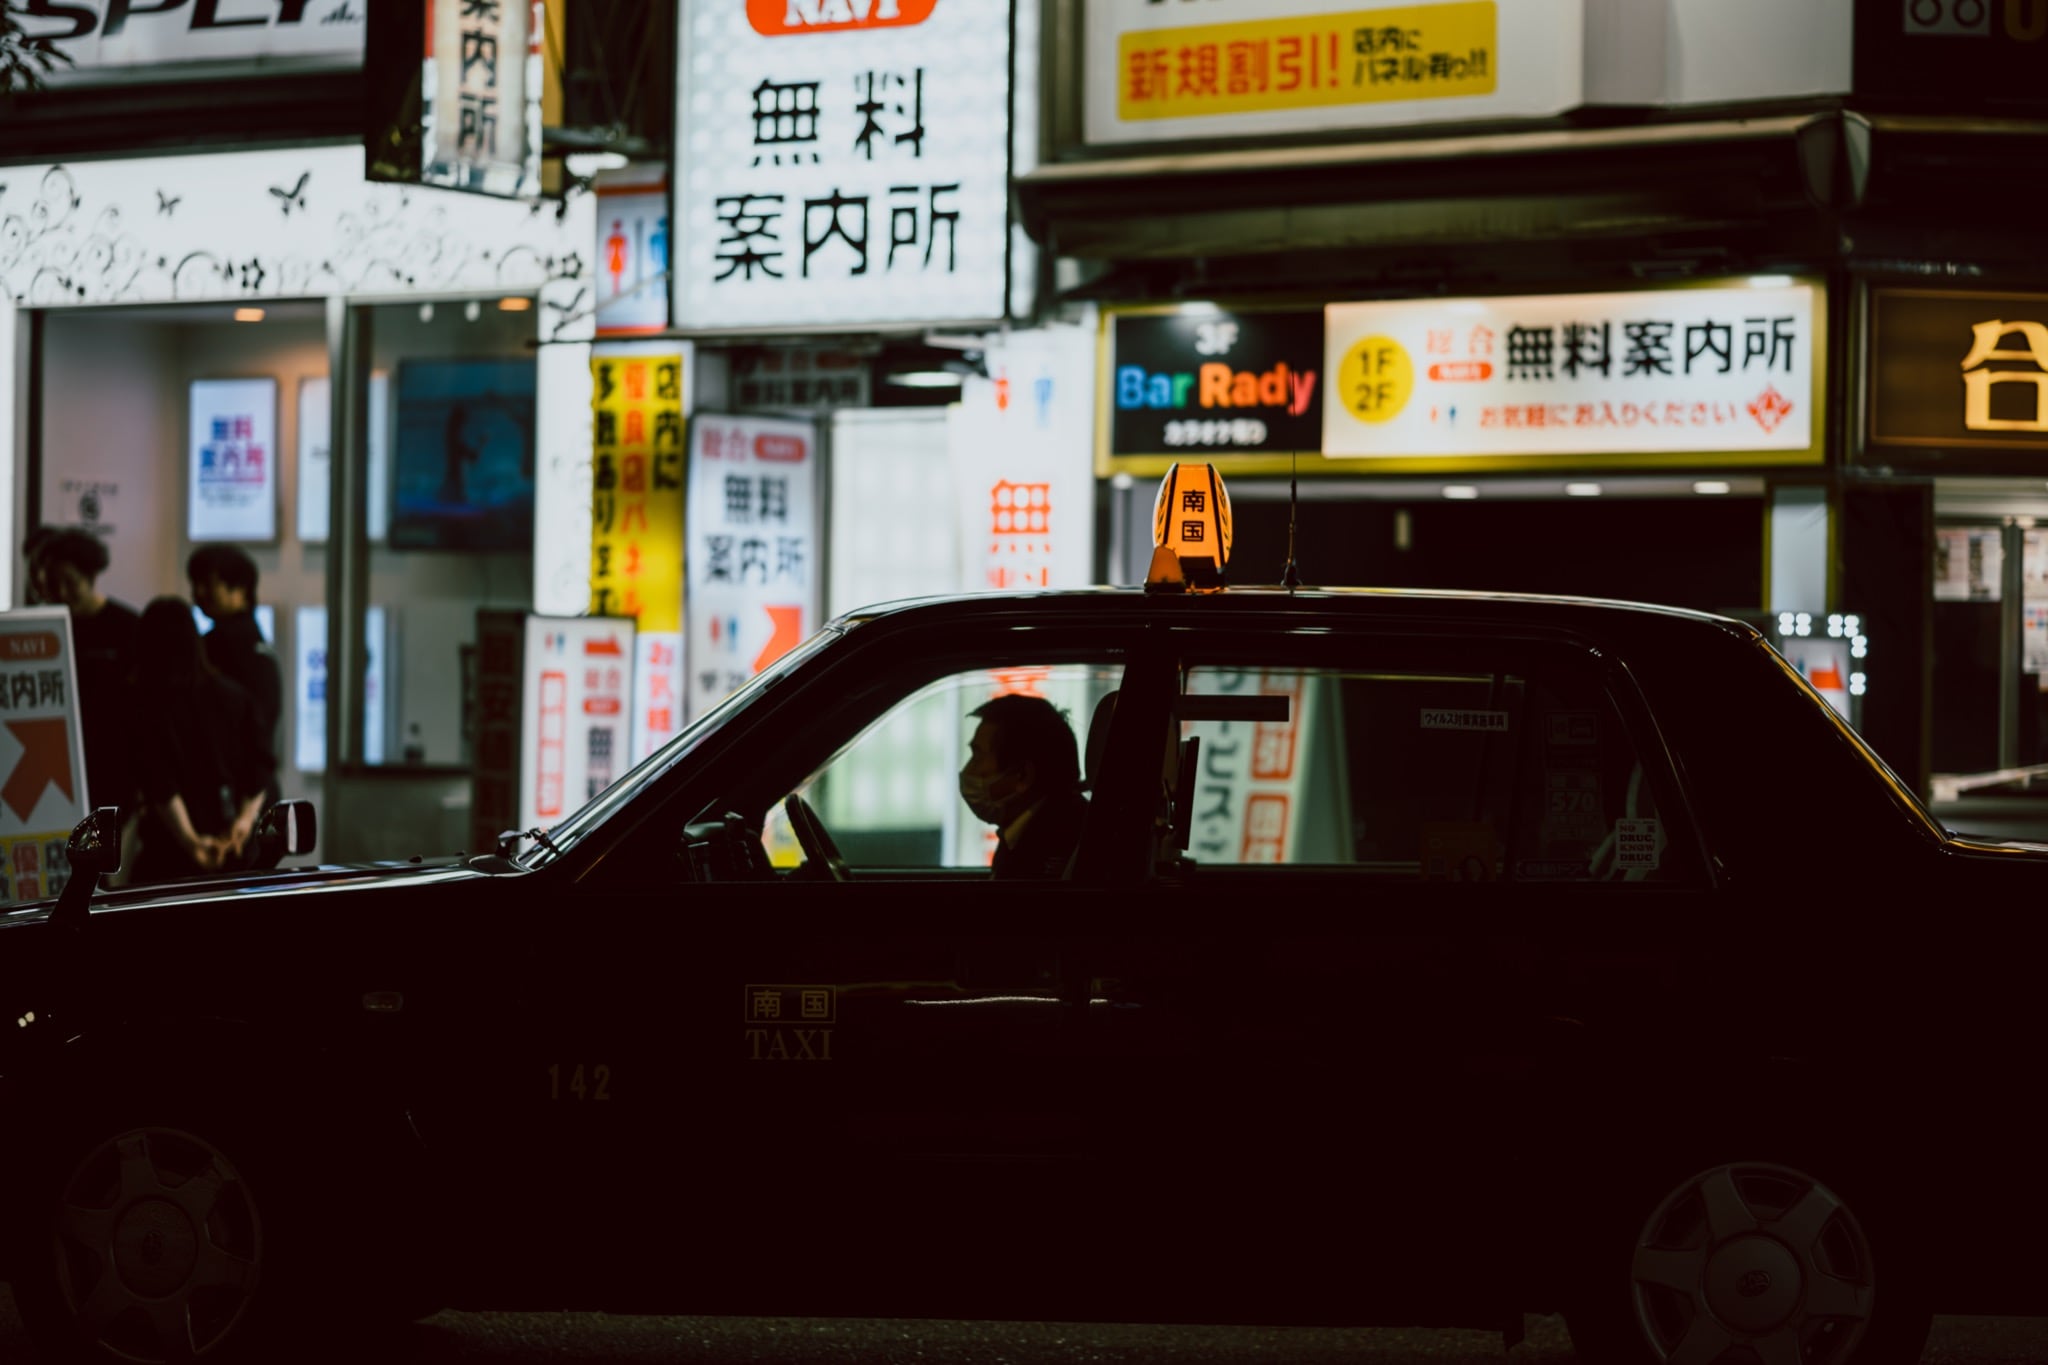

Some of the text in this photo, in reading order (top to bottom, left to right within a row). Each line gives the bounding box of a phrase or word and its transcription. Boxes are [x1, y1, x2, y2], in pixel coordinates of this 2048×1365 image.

[752, 67, 925, 168] 無料
[713, 182, 961, 282] 案内所
[1195, 322, 1239, 355] 3F
[1505, 315, 1797, 381] 無料案内所
[1357, 347, 1395, 377] 1F
[1117, 361, 1317, 416] Bar Rady
[1354, 381, 1395, 414] 2F
[1479, 401, 1738, 429] お気軽にお入りください
[724, 473, 790, 523] 無料
[1181, 489, 1206, 542] 南国
[704, 534, 805, 585] 案内所
[10, 637, 47, 655] NAVI
[752, 989, 829, 1019] 南国
[745, 1029, 835, 1061] TAXI
[547, 1063, 611, 1101] 142
